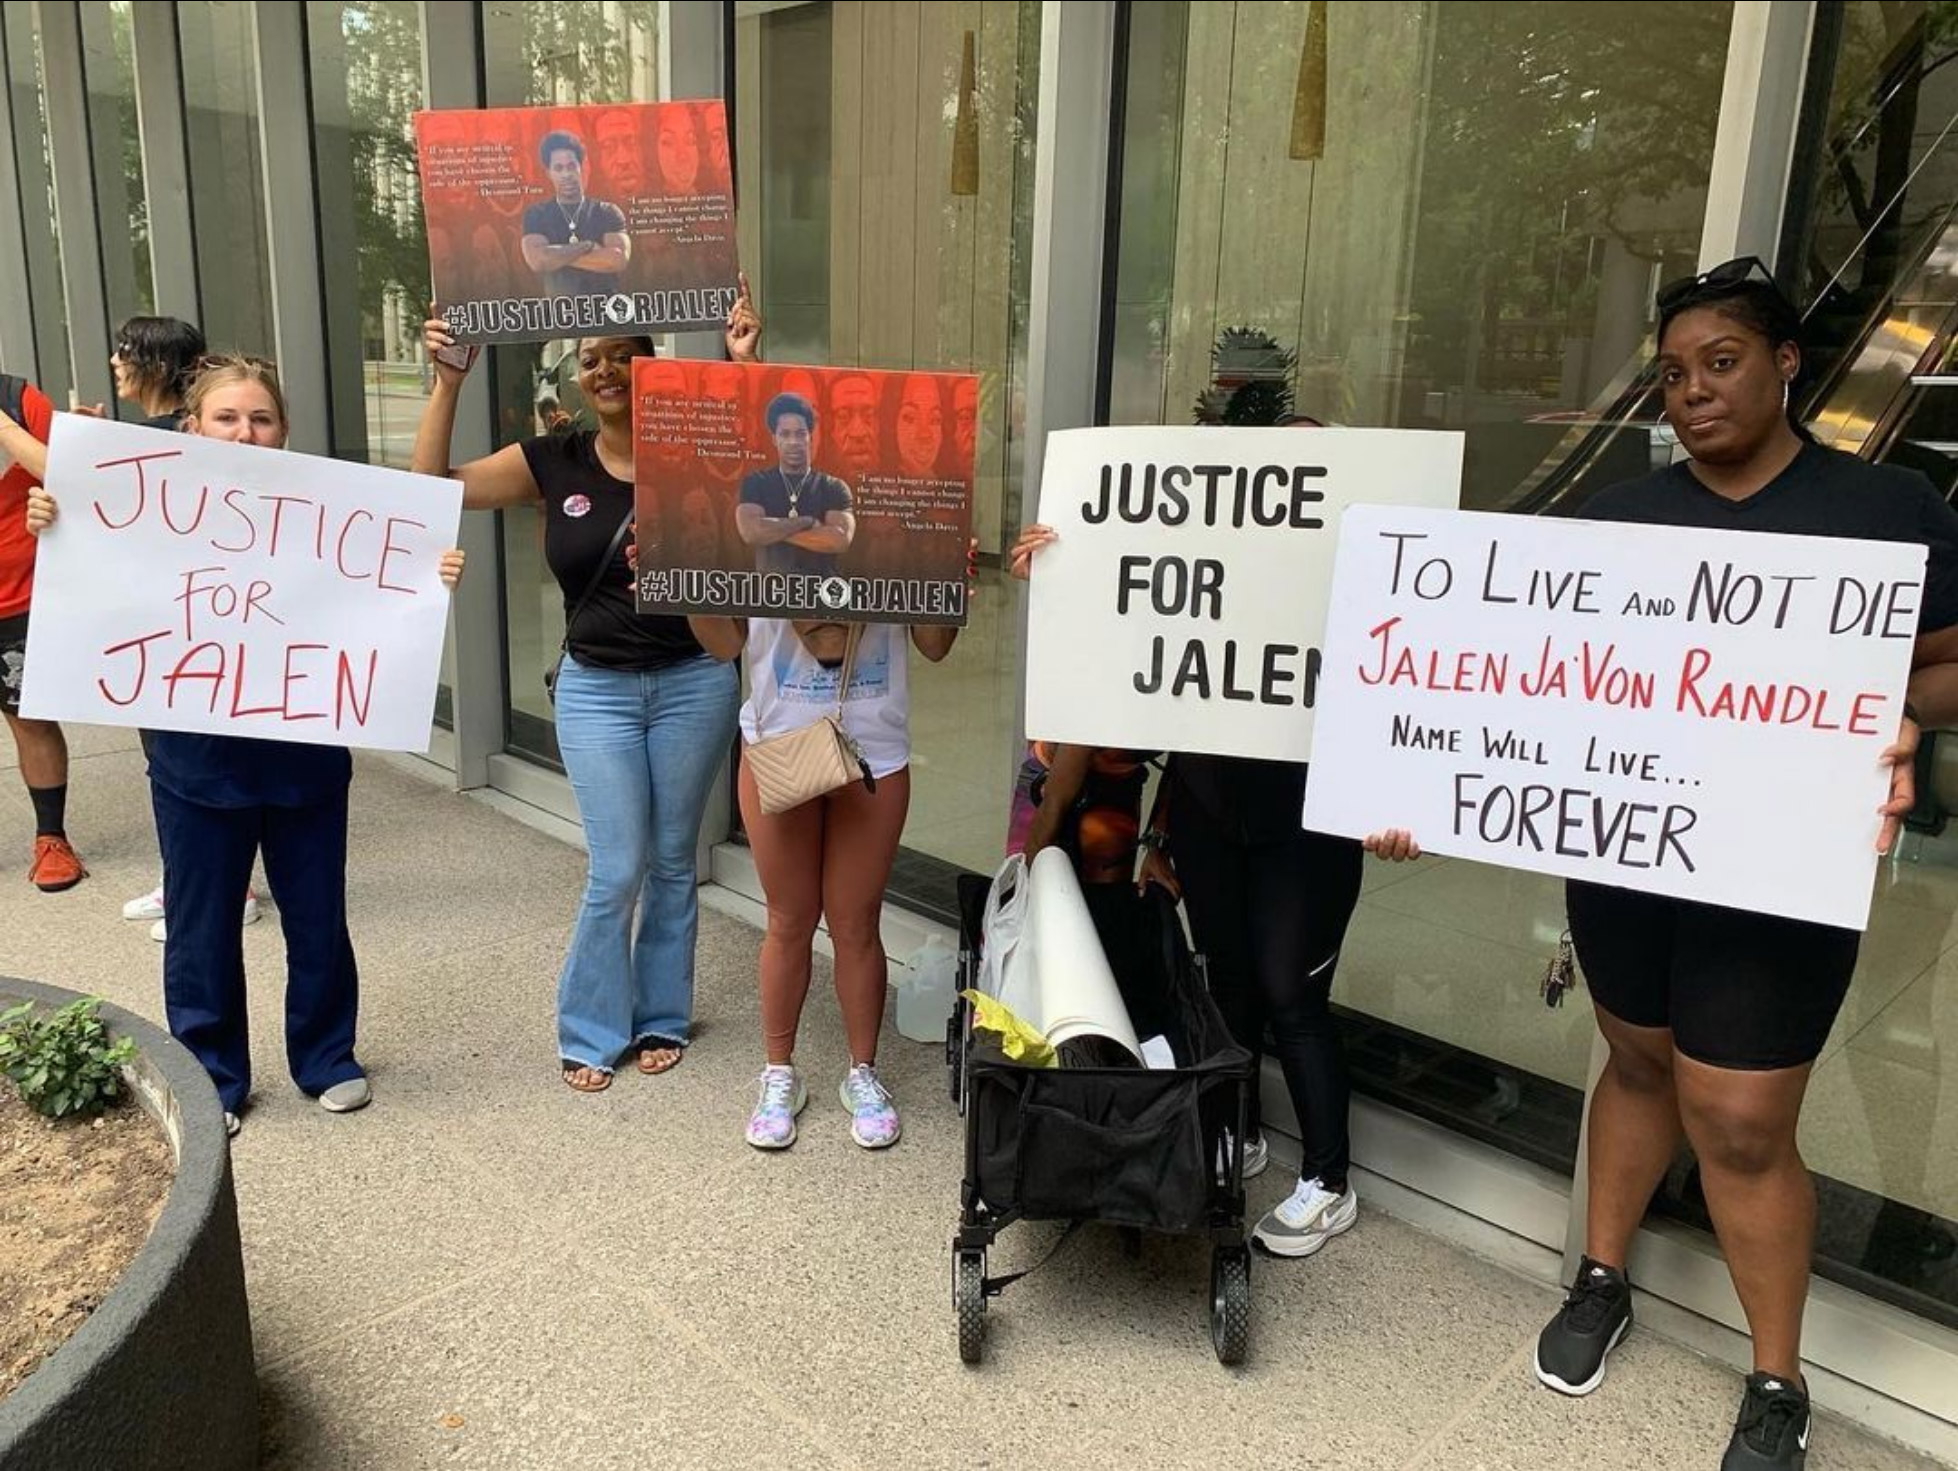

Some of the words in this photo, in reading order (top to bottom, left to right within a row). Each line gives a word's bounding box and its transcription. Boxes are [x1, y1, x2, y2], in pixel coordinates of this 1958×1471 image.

[94, 450, 426, 594] JUSTICE
[1082, 462, 1328, 529] JUSTICE
[174, 566, 285, 641] FOR
[1117, 555, 1225, 620] FOR
[1621, 590, 1676, 617] AND
[1686, 560, 1817, 629] NOT
[1829, 576, 1921, 639] DIE
[98, 630, 378, 731] JALEN
[1358, 616, 1509, 694] JALEN
[1676, 648, 1888, 735] RANDLE
[1391, 714, 1463, 753] NAME
[1483, 726, 1549, 766] WILL
[1454, 773, 1698, 873] FOREVER
